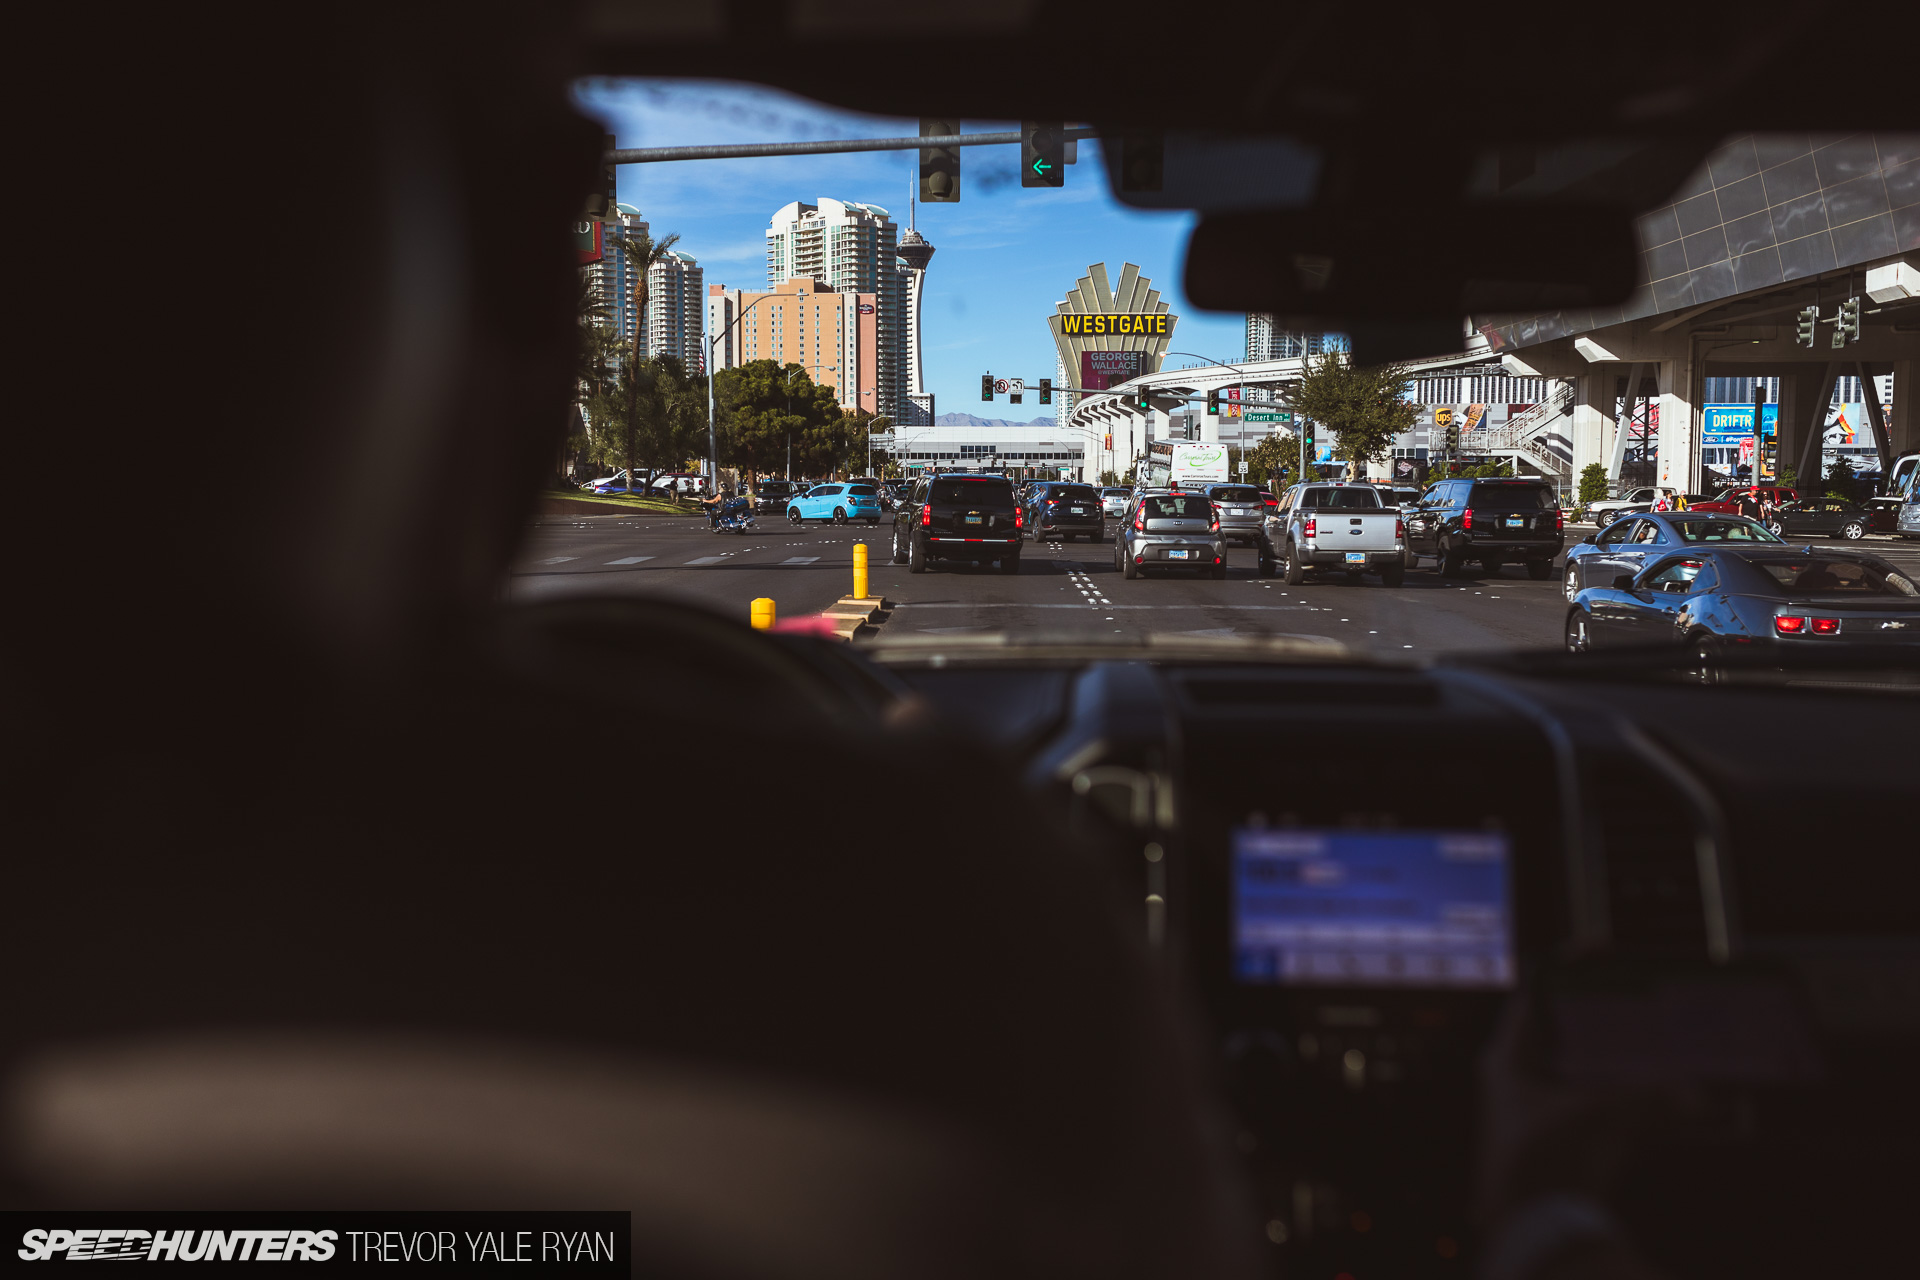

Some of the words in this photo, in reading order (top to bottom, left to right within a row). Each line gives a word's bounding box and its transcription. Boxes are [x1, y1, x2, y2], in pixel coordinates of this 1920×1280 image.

[1063, 315, 1166, 333] WESTGATE
[1091, 352, 1137, 361] GEORGE
[1091, 361, 1137, 370] WALLACE
[1437, 413, 1451, 424] ups
[1713, 414, 1752, 427] DR1FTR
